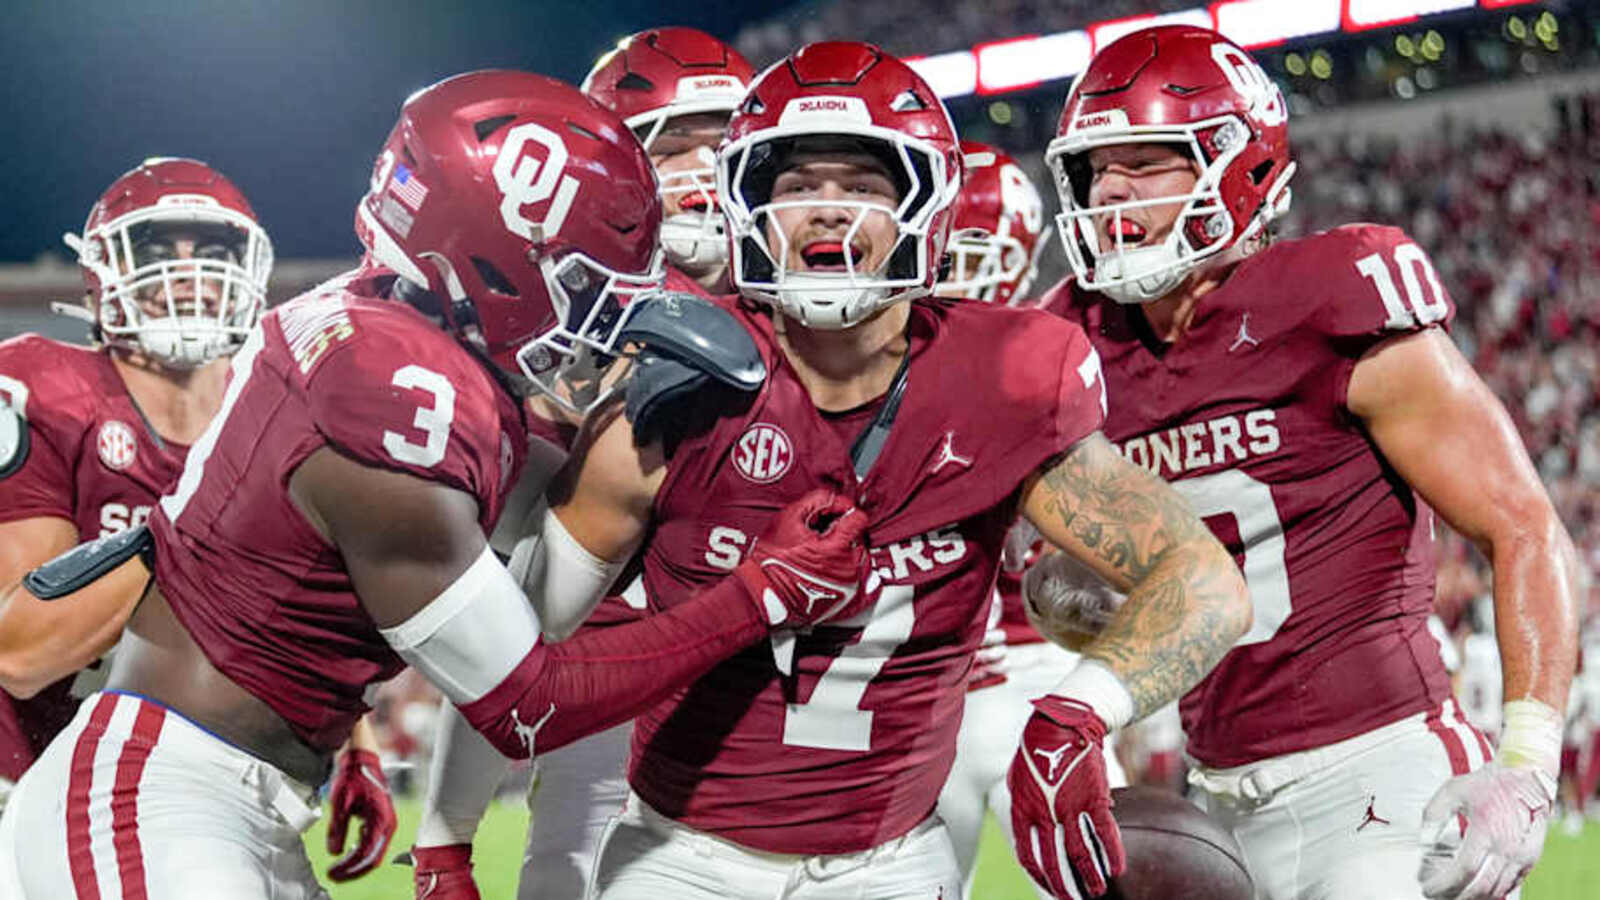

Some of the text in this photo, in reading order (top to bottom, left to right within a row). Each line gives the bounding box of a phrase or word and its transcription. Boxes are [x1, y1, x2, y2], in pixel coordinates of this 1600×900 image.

[800, 99, 848, 111] OKLAHOMA
[492, 122, 581, 243] OU
[1354, 242, 1448, 328] 10
[382, 364, 456, 469] 3
[737, 427, 788, 479] SEC
[768, 583, 915, 752] 7
